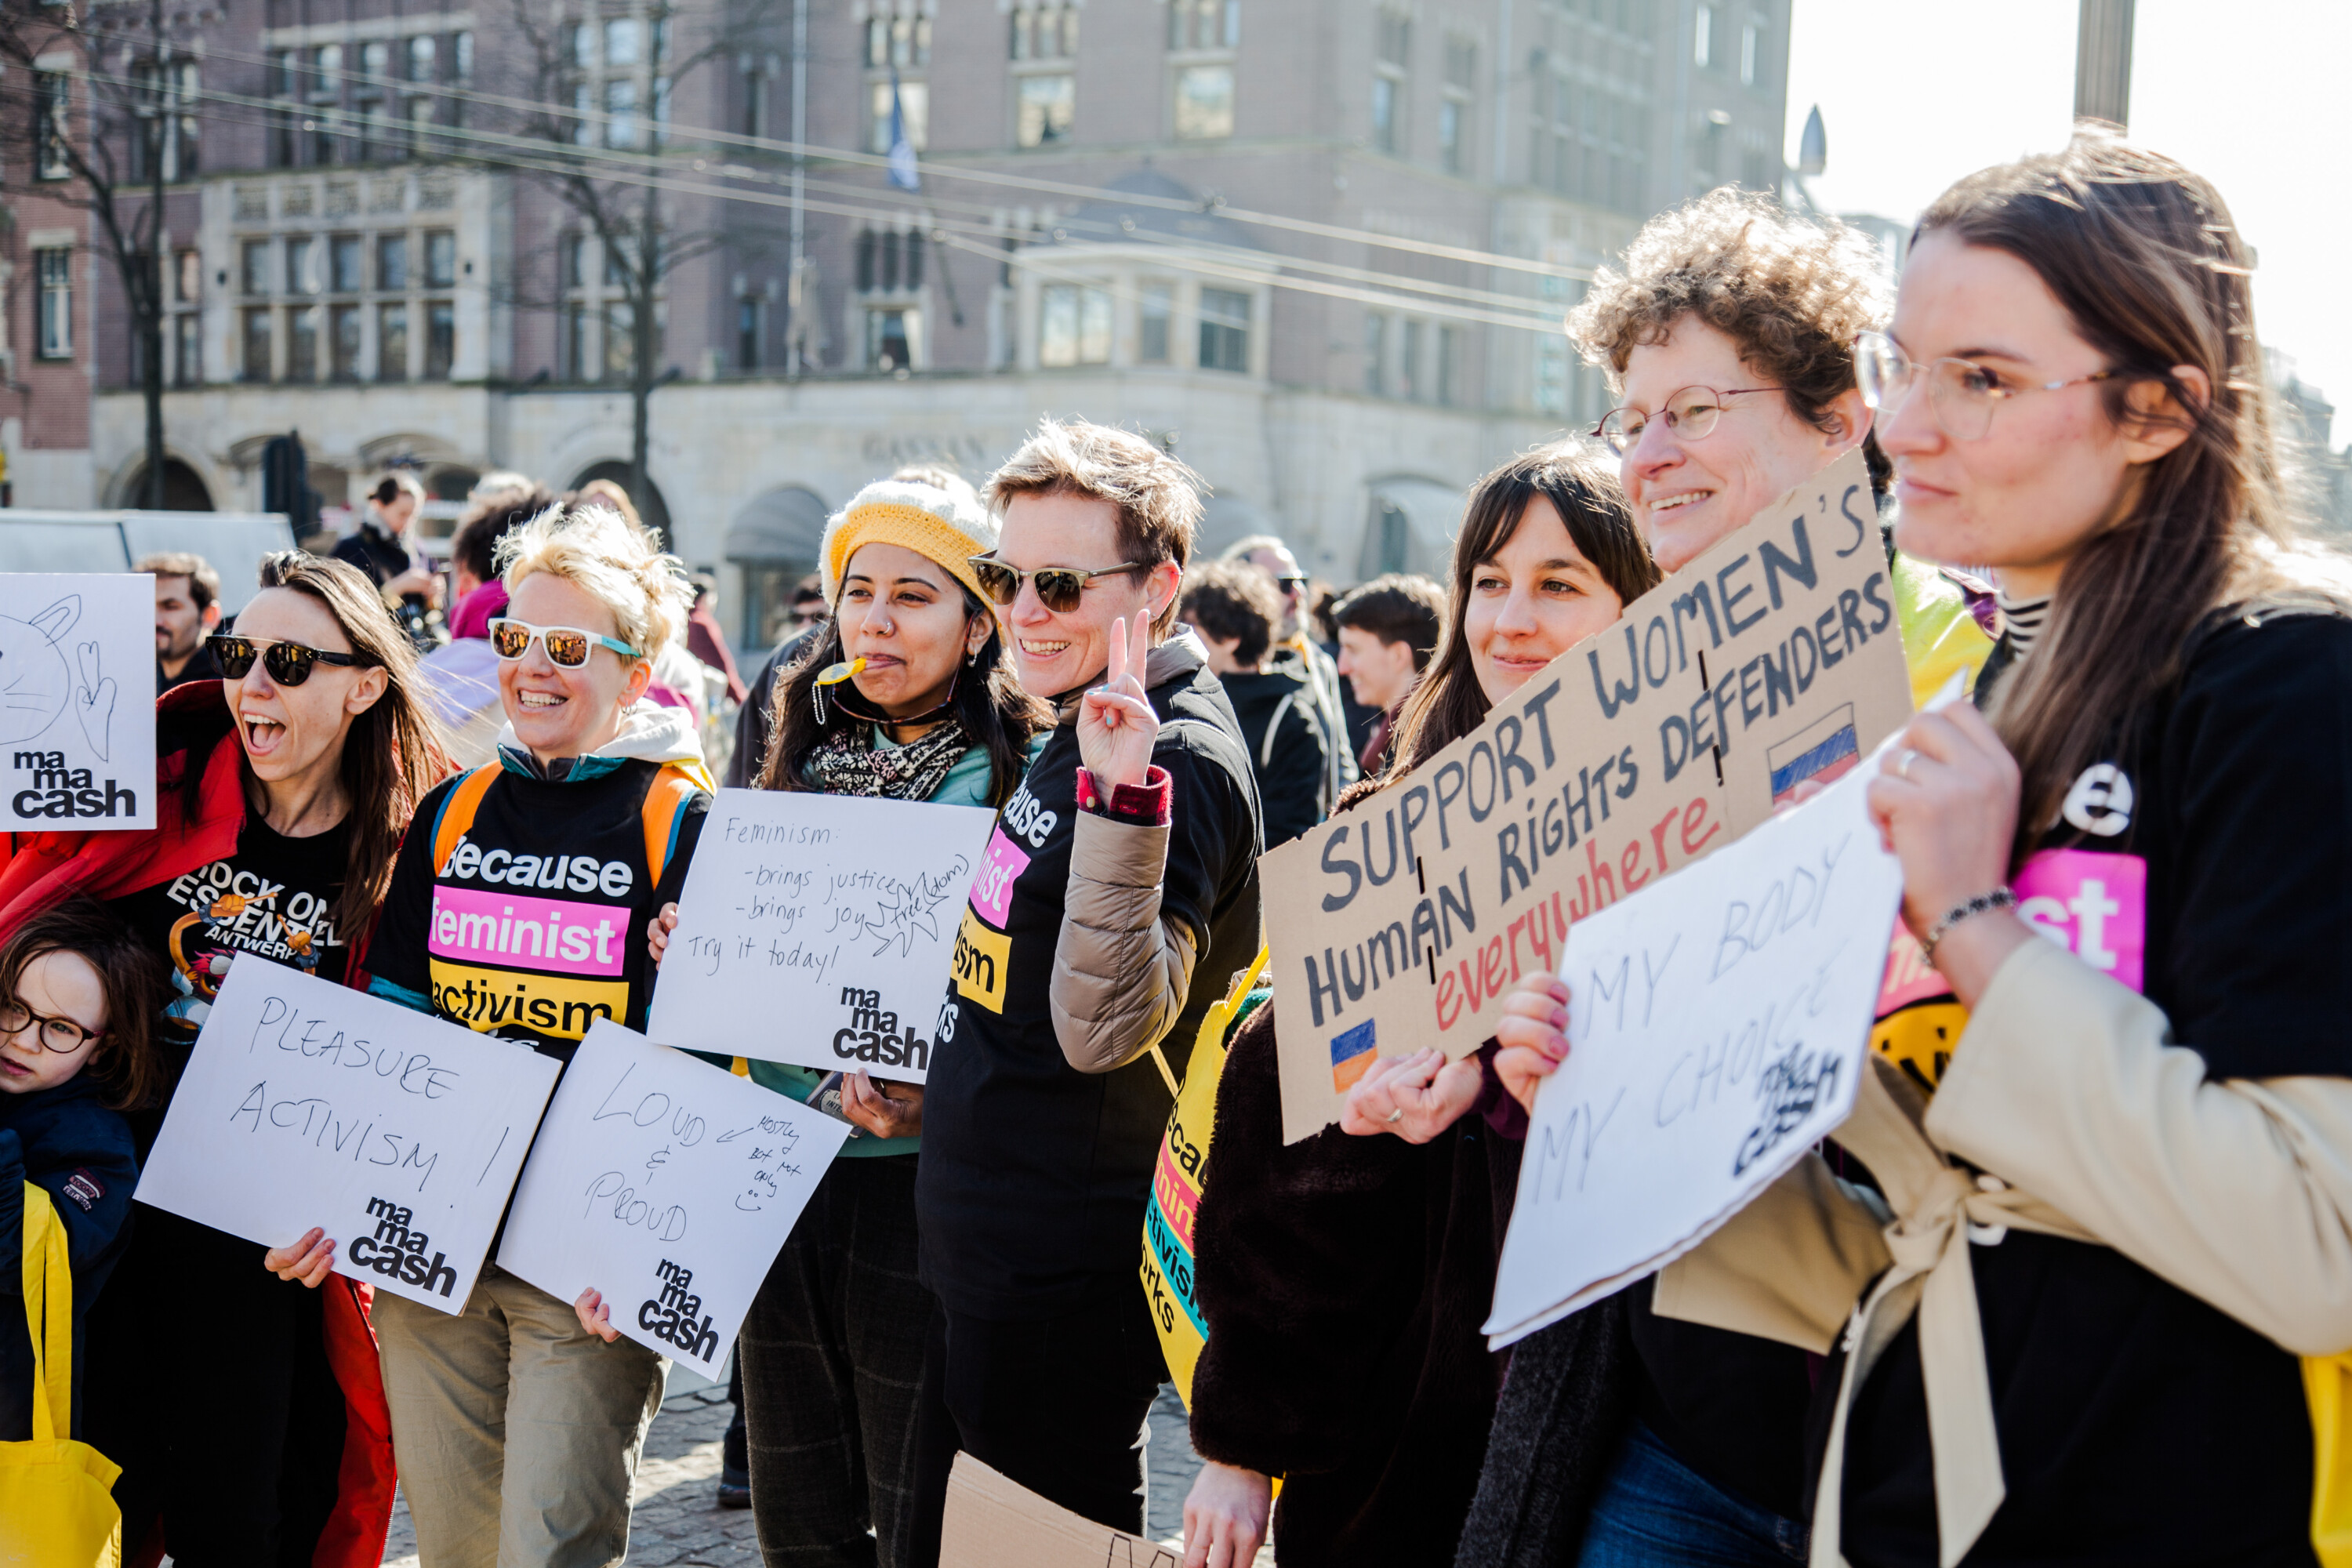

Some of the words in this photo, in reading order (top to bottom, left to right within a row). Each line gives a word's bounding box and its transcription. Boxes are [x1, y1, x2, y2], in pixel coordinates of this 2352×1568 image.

[1321, 678, 1561, 913] SUPPORT
[1587, 485, 1864, 720] WOMEN'S
[14, 751, 65, 769] ma
[33, 768, 93, 789] ma
[12, 779, 136, 819] cash
[1004, 775, 1058, 848] ause
[1305, 866, 1476, 1028] HUMAN
[1659, 572, 1891, 783] DEFENDERS
[725, 818, 840, 845] Feminism:
[975, 848, 1015, 913] nist
[432, 896, 615, 964] feminist
[824, 898, 865, 941] joy
[1436, 797, 1720, 1032] everywhere
[1583, 933, 1681, 1040] MY
[1708, 831, 1853, 985] BODY
[688, 936, 722, 976] Try
[737, 935, 757, 960] it
[768, 941, 839, 987] today!
[433, 978, 612, 1034] activism
[840, 986, 880, 1009] ma
[851, 1007, 898, 1034] ma
[249, 996, 459, 1099] PLEASURE
[833, 1027, 929, 1071] cash
[1533, 1086, 1627, 1206] MY
[1656, 938, 1850, 1129] CHOICE
[593, 1062, 706, 1147] LOUD
[826, 1100, 843, 1113] INTE
[646, 1145, 670, 1185] &
[366, 1196, 413, 1227] ma
[584, 1171, 686, 1242] PROUD
[374, 1218, 429, 1255] ma
[349, 1236, 457, 1298] cash
[655, 1258, 693, 1289] ma
[1142, 1243, 1174, 1334] orks
[659, 1283, 702, 1319] ma
[638, 1300, 719, 1363] cash
